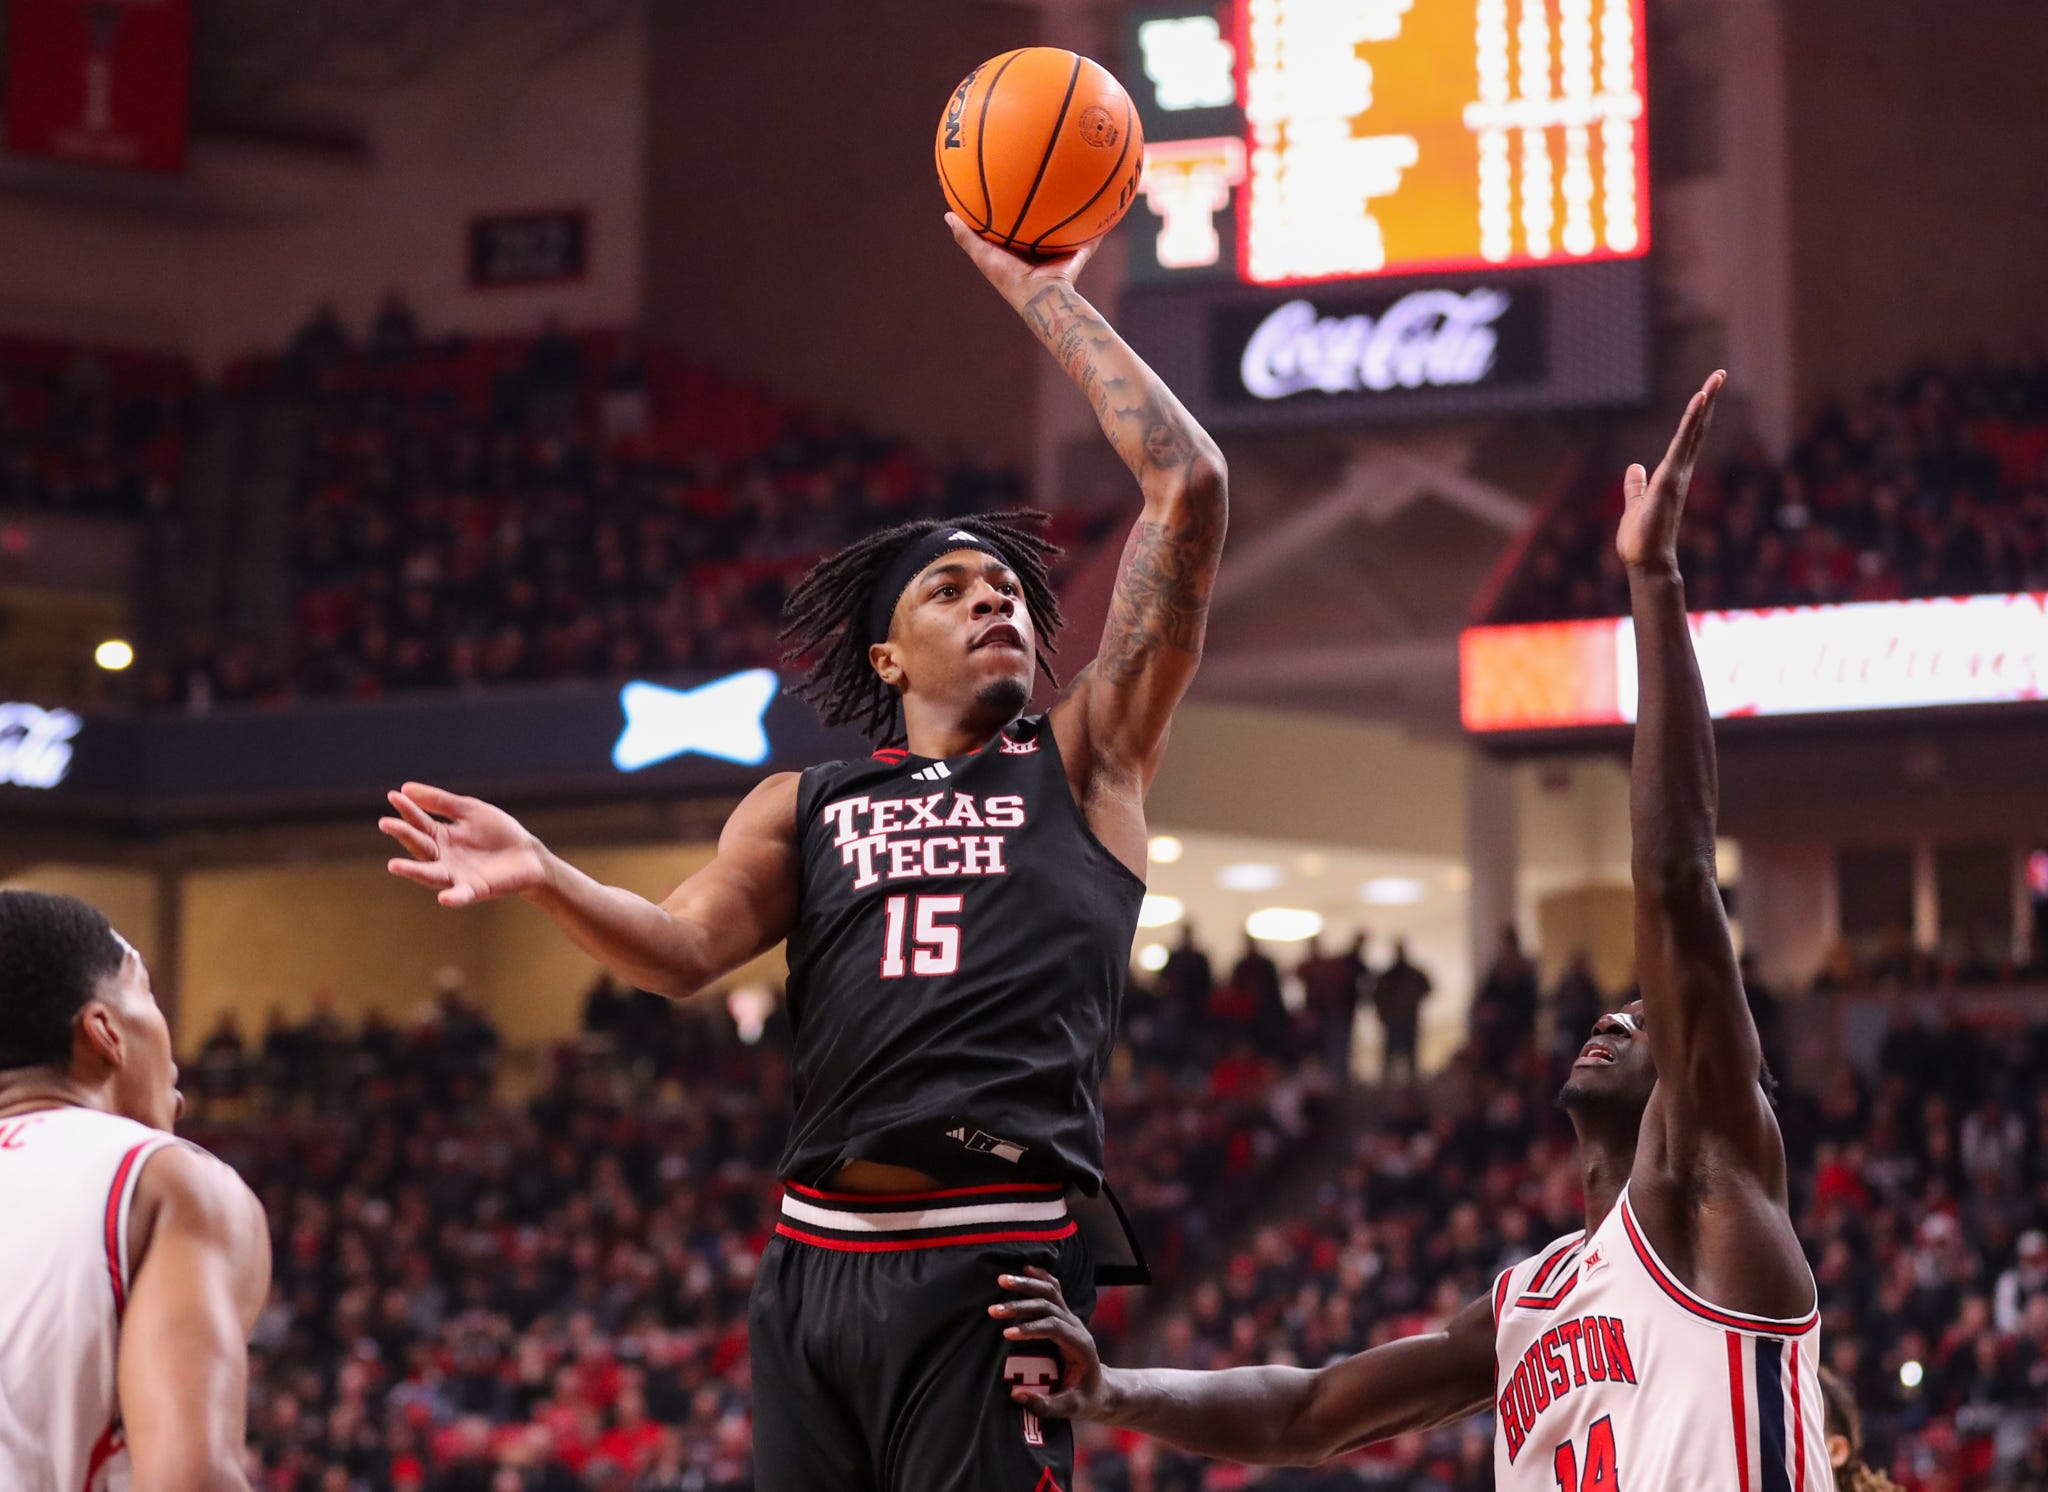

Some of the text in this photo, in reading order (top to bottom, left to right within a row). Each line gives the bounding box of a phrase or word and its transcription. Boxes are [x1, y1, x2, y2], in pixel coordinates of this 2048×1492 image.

[824, 791, 1026, 848] TEXAS
[842, 833, 1007, 890] TECH
[880, 894, 964, 979] 15
[1498, 1315, 1638, 1466] HOUSTON
[1553, 1413, 1620, 1492] 14
